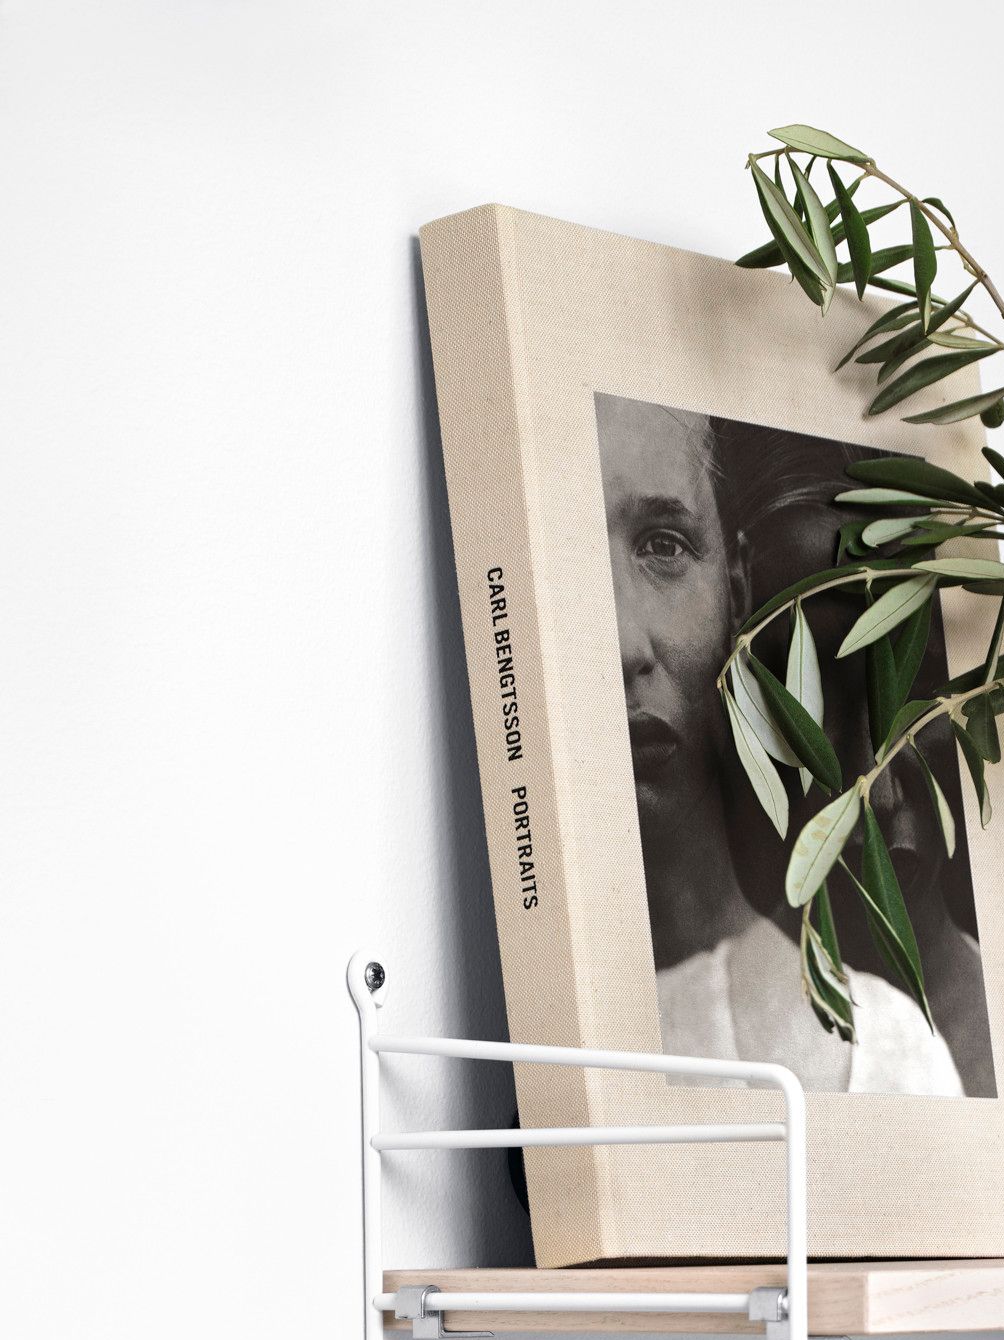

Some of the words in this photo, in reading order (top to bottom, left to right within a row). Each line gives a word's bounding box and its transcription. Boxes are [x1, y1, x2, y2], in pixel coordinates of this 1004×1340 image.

[485, 566, 507, 627] CARL
[492, 630, 523, 762] BENGTSSON
[510, 786, 541, 909] PORTRAITS
